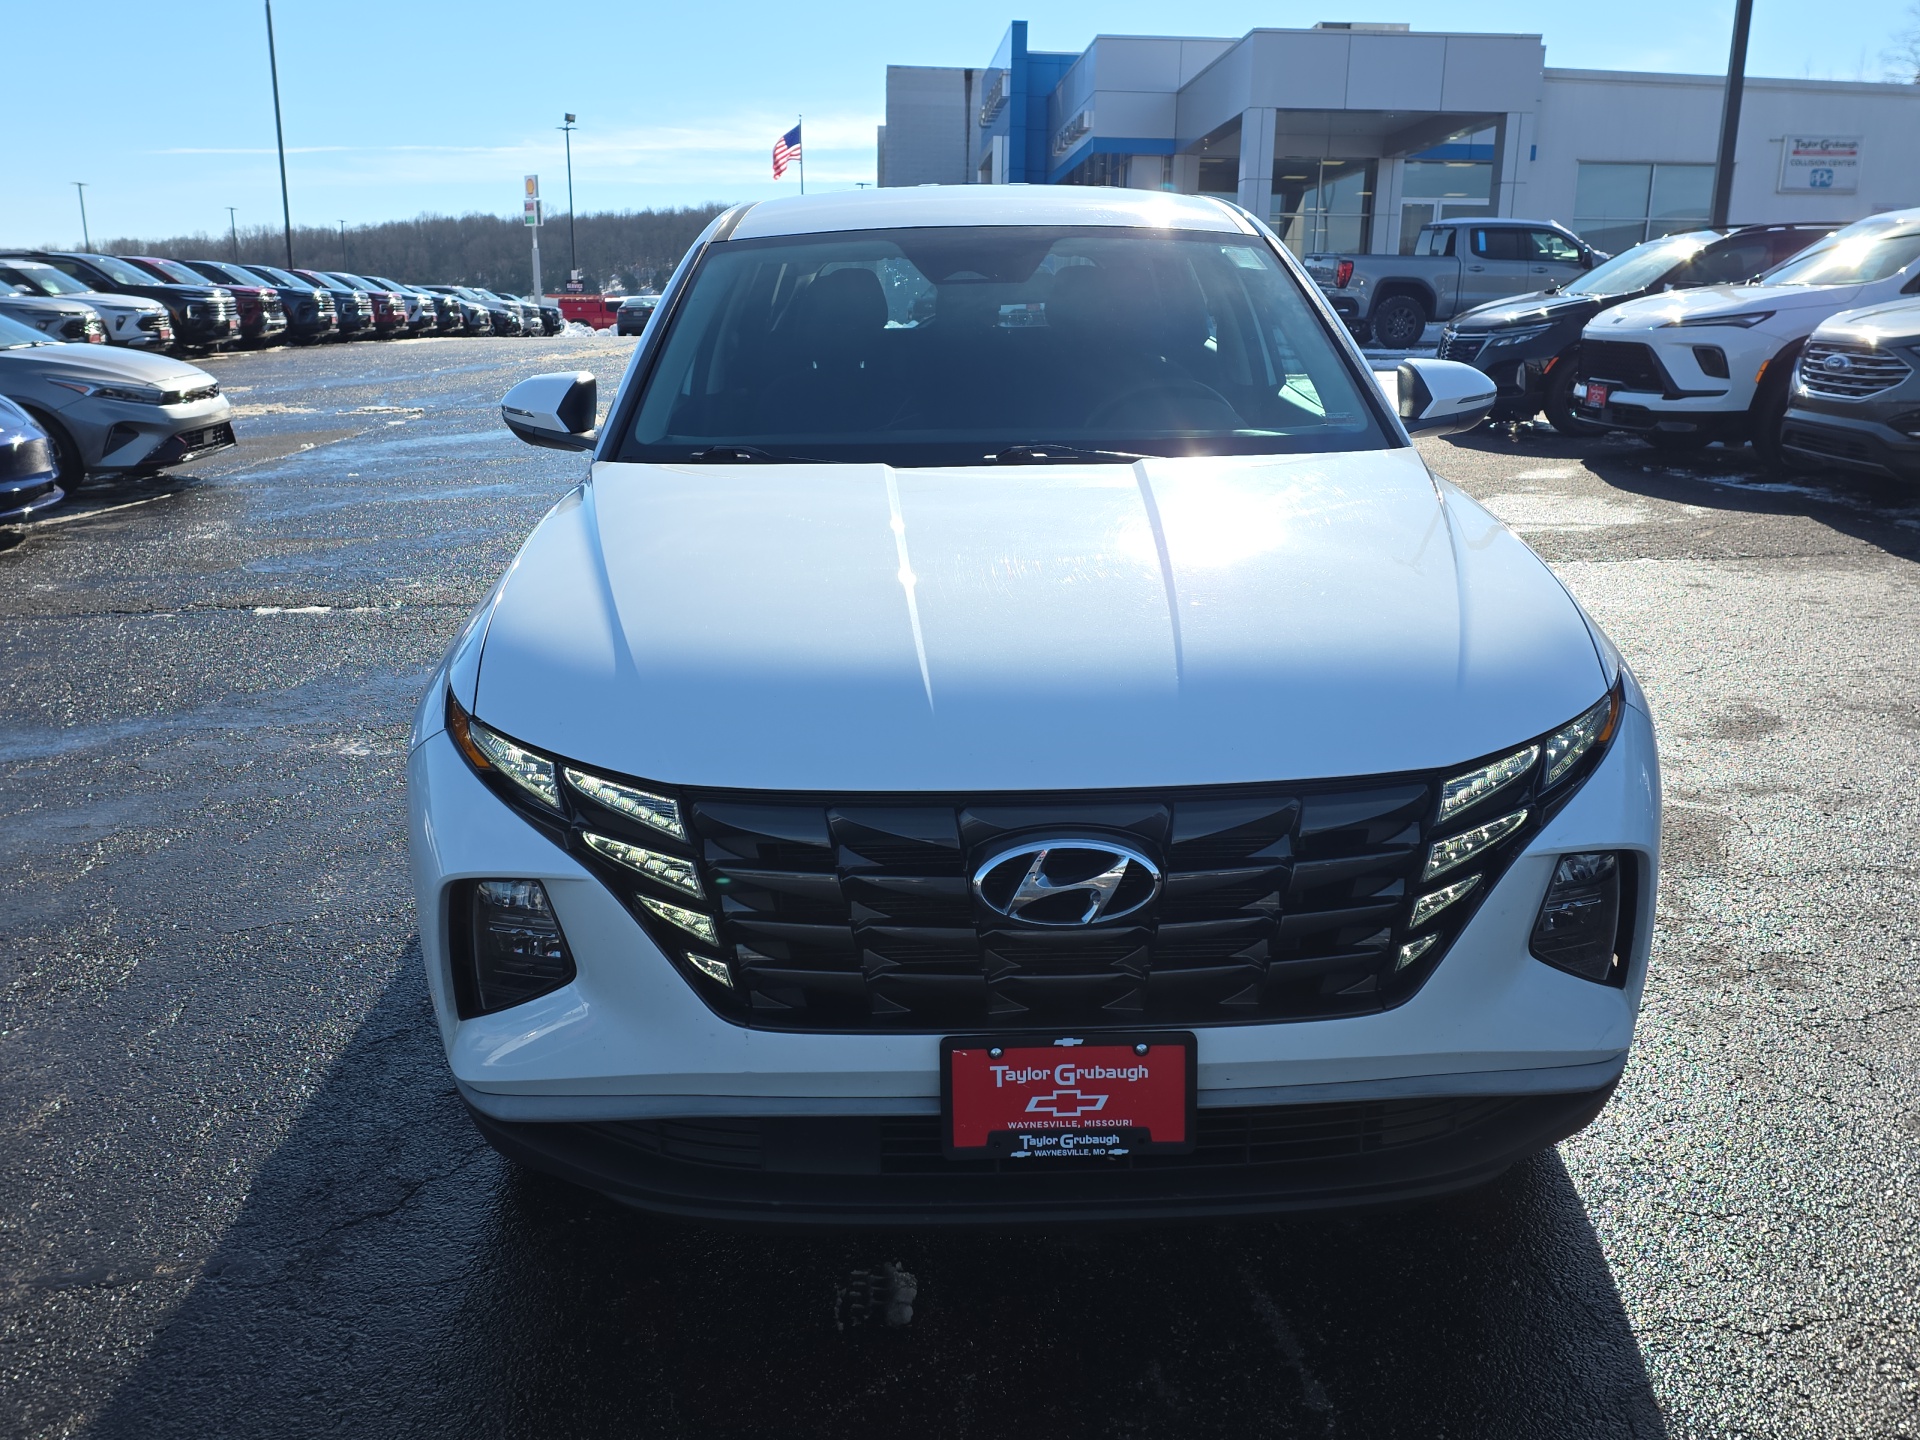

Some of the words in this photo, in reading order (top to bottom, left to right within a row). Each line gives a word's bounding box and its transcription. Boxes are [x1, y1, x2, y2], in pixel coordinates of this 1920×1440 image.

[1794, 139, 1818, 150] Taylor
[1811, 170, 1833, 187] PPG
[989, 1065, 1051, 1088] Taylor
[1054, 1063, 1149, 1086] Grubaugh
[1007, 1120, 1081, 1129] WAYNESVILLE,
[1084, 1119, 1133, 1128] MISSOURI
[1019, 1135, 1058, 1150] Taylor
[1060, 1134, 1120, 1149] Grubaugh
[1034, 1149, 1091, 1157] WAYNESVILLE,
[1093, 1148, 1106, 1156] MO
